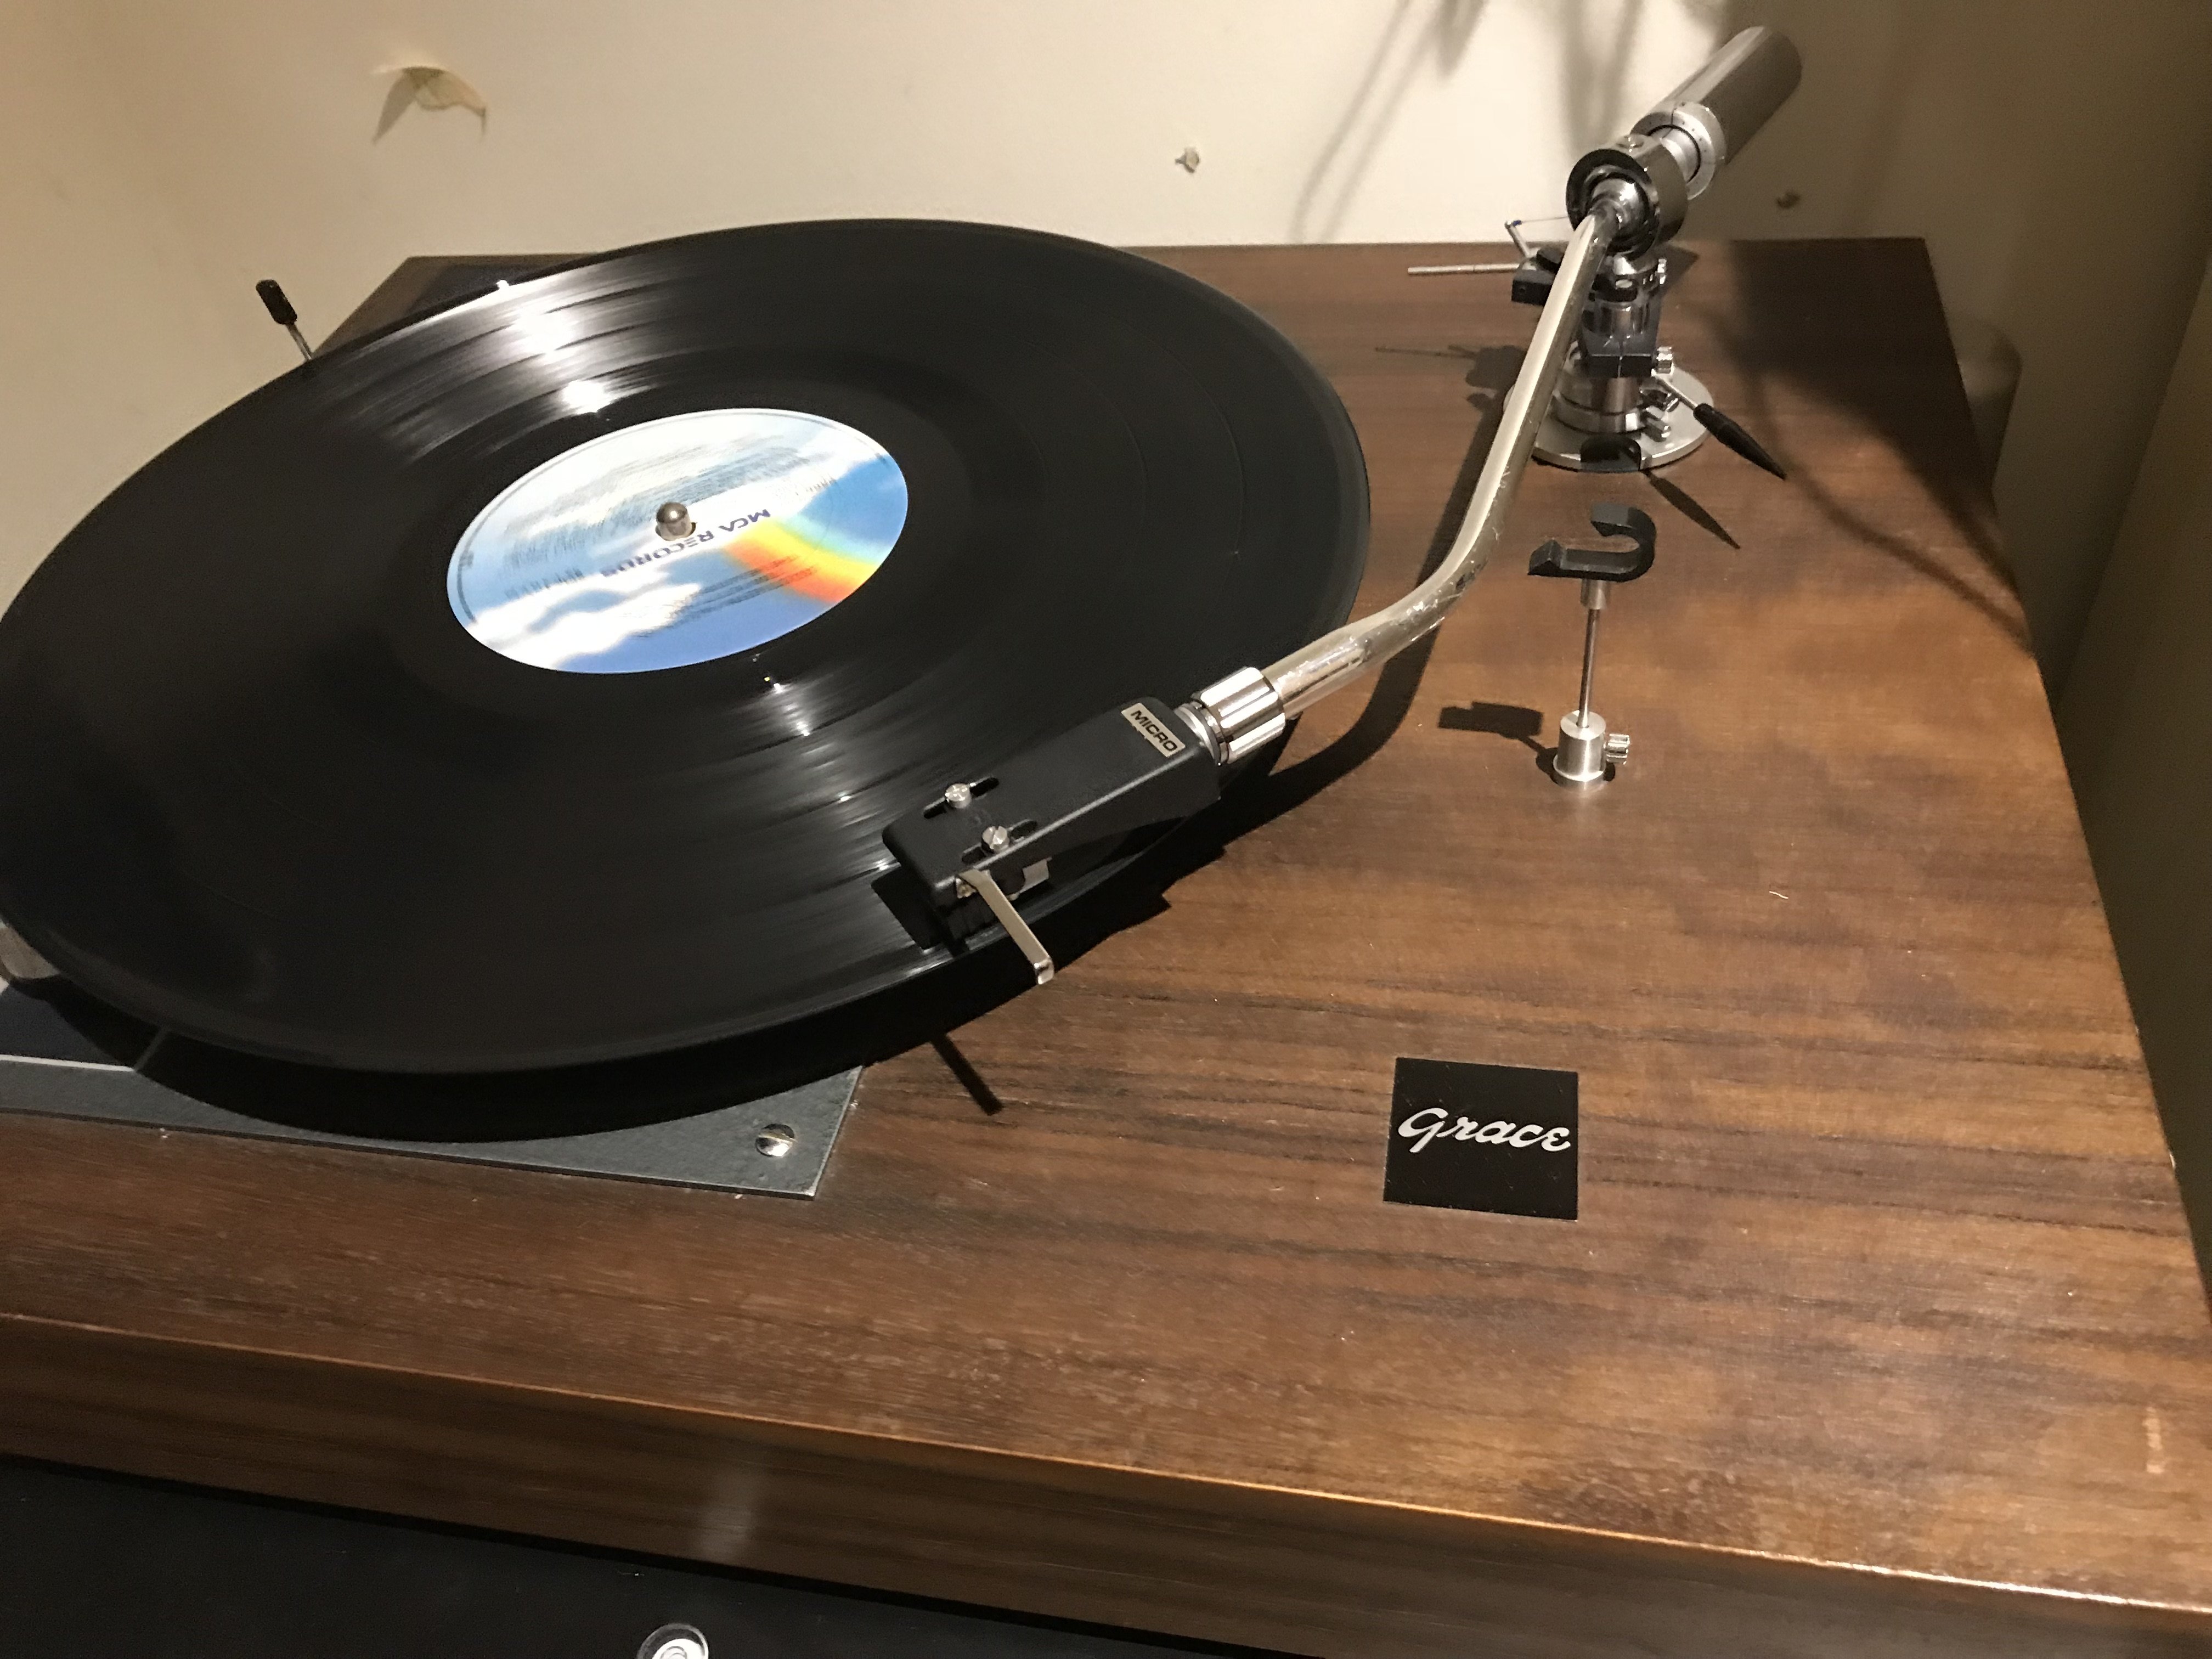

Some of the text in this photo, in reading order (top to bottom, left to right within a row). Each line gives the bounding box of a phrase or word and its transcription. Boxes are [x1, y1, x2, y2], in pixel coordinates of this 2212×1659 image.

[718, 509, 771, 532] MCA
[1131, 710, 1178, 752] MICRO
[1398, 1108, 1571, 1153] Grace
